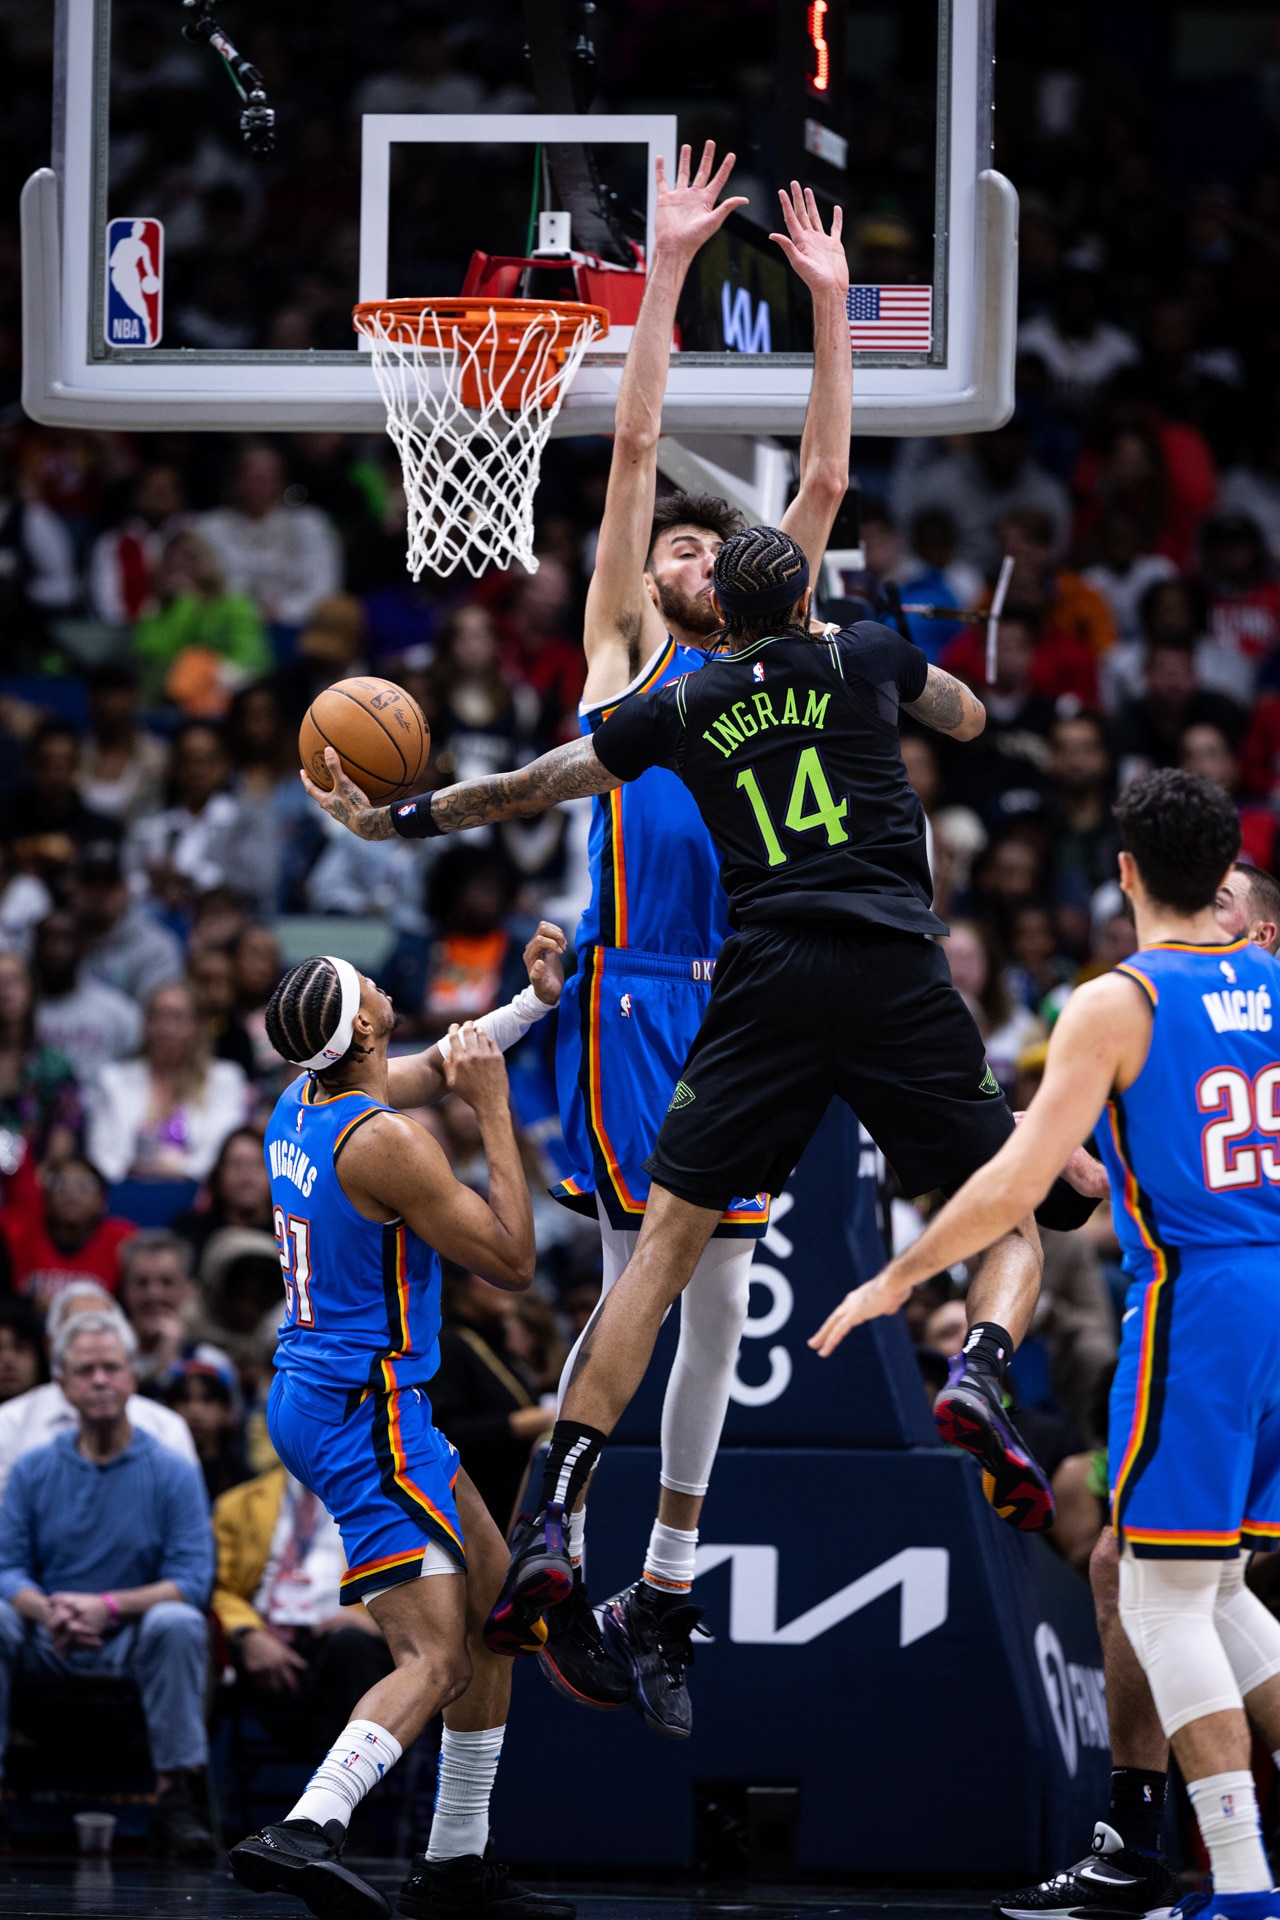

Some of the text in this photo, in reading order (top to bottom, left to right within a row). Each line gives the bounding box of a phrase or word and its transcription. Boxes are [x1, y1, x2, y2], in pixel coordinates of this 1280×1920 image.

[112, 318, 140, 339] NBA
[702, 688, 831, 758] INGRAM
[735, 745, 849, 868] 14
